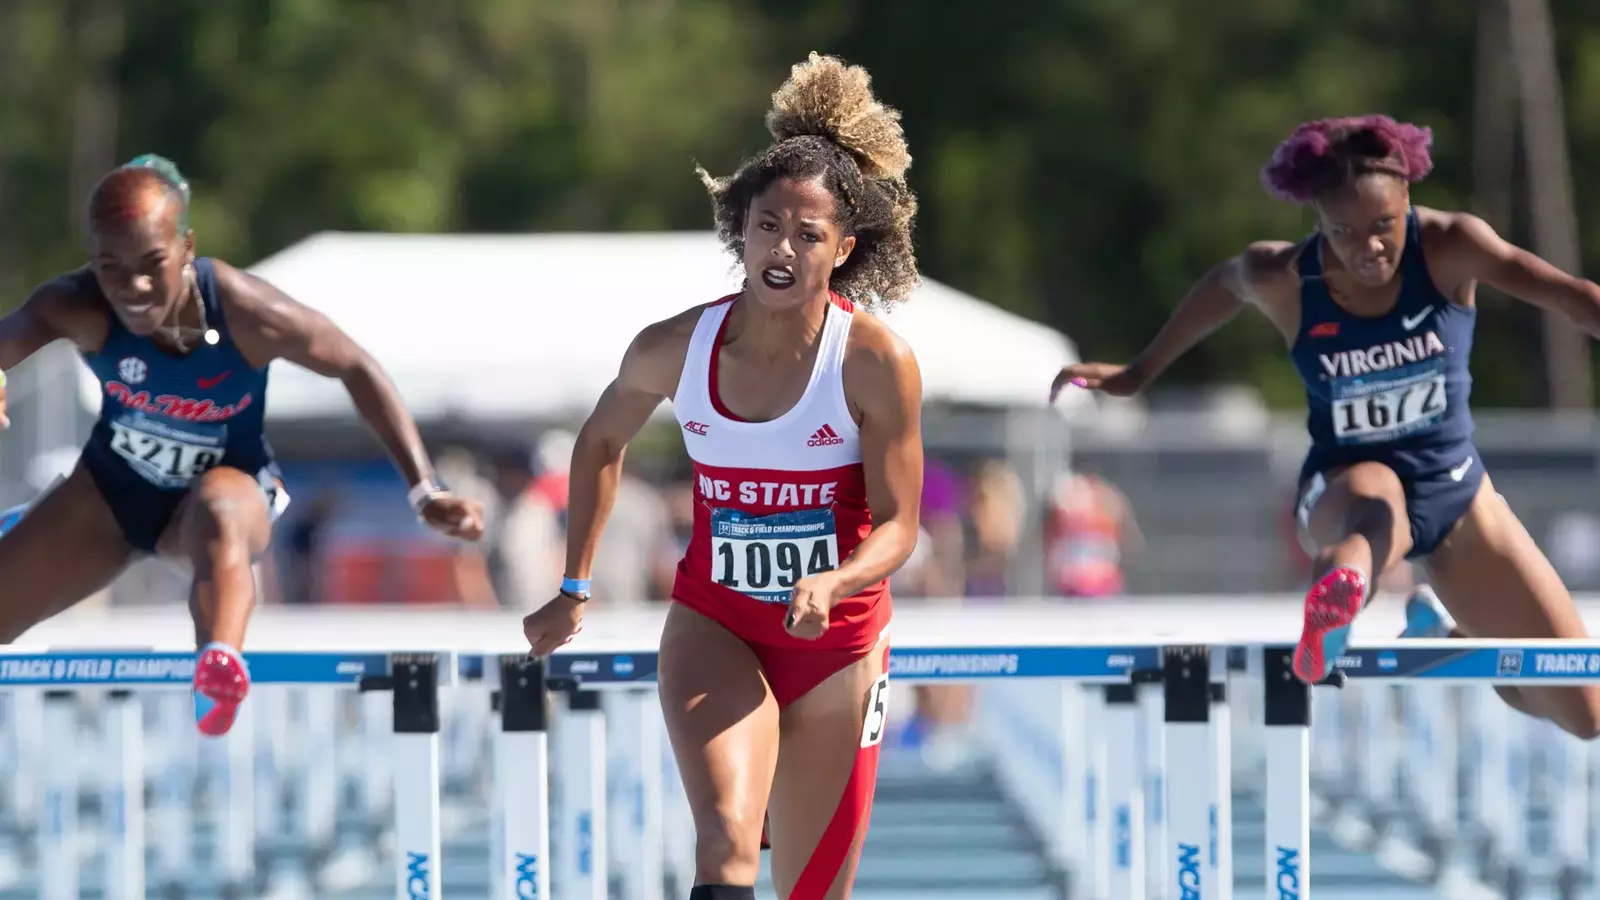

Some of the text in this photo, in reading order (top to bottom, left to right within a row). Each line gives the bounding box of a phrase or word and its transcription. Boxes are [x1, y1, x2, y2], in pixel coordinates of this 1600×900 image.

[1319, 330, 1445, 377] VIRGINIA
[1341, 379, 1442, 431] 1672
[683, 421, 710, 436] ACC
[807, 437, 844, 447] adidas
[699, 473, 838, 507] NC STATE
[731, 525, 749, 534] TRACK
[755, 525, 772, 534] FIELD
[773, 522, 825, 533] CHAMPIONSHIPS
[717, 539, 835, 588] 1094
[1535, 653, 1588, 674] TRACK
[869, 680, 887, 741] 5
